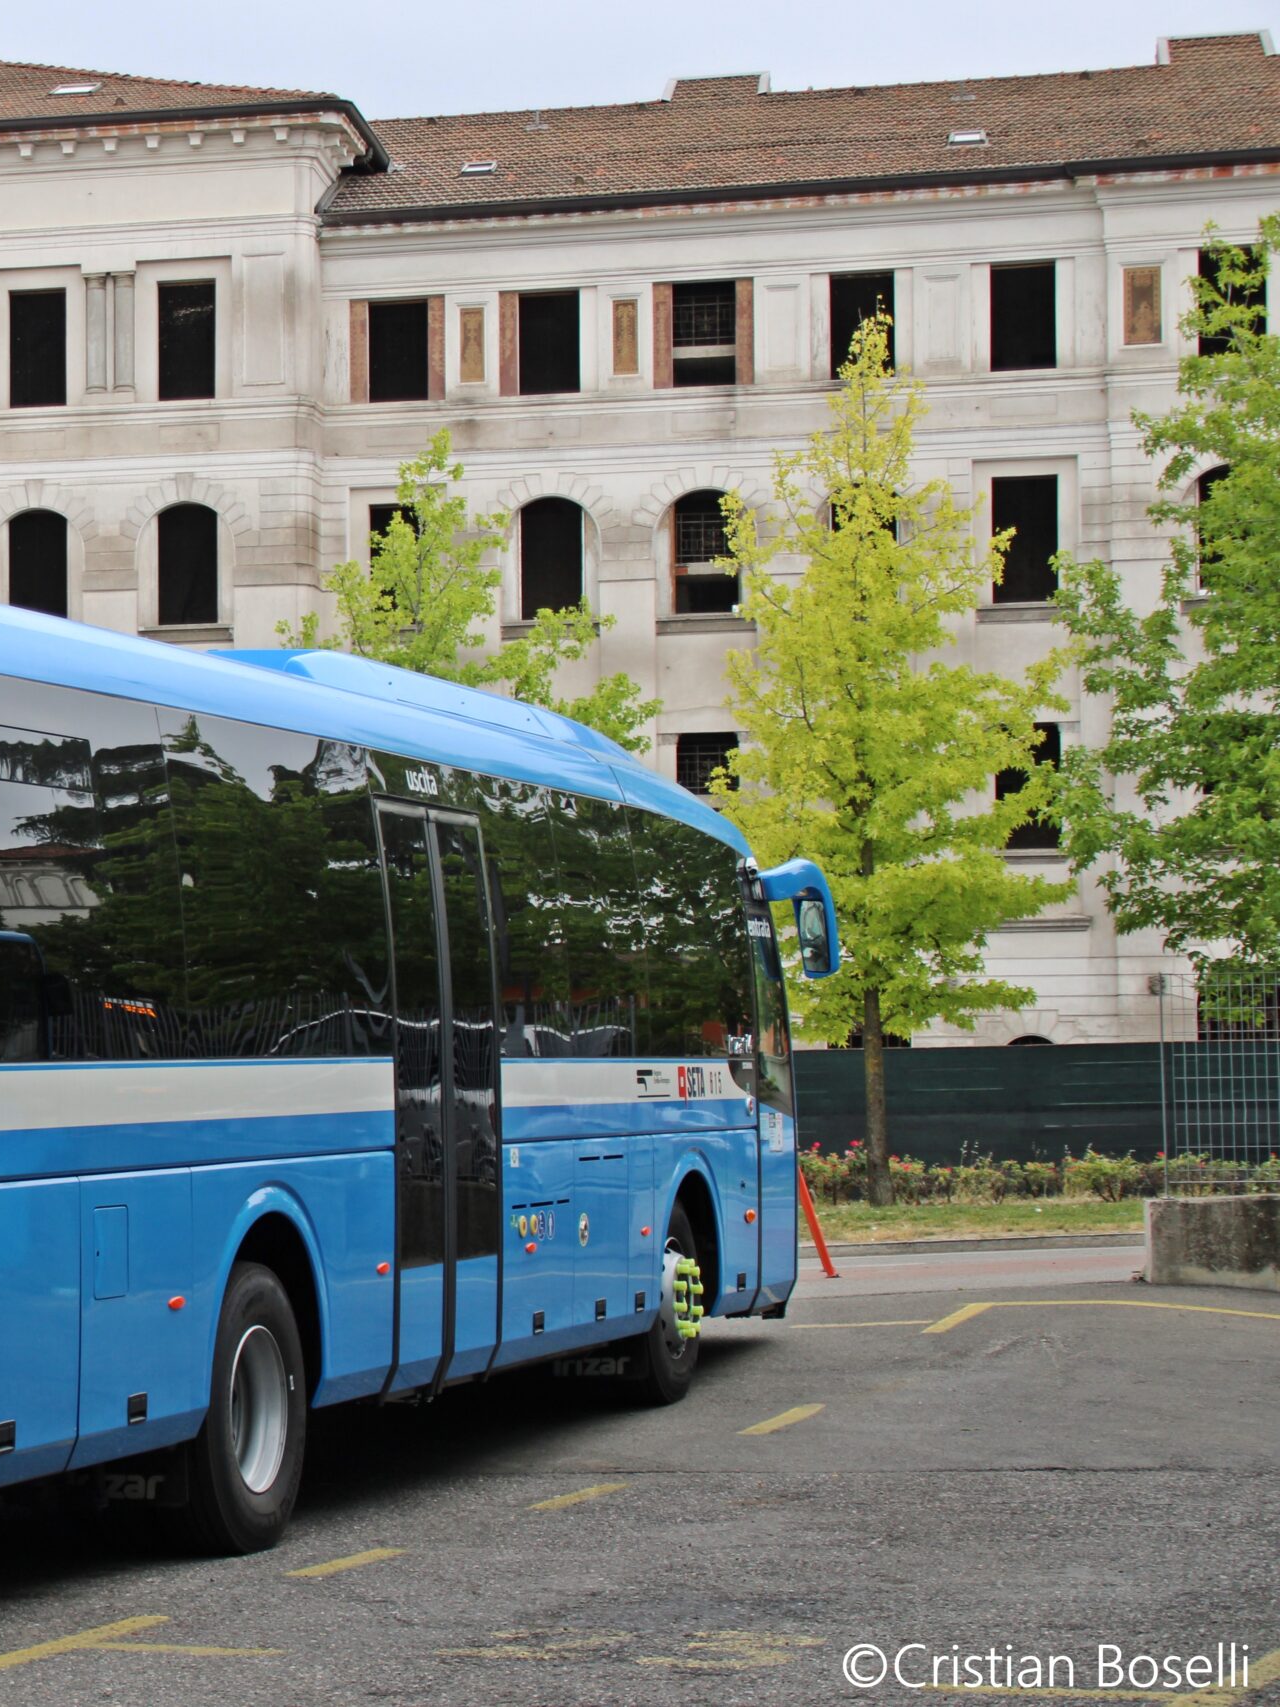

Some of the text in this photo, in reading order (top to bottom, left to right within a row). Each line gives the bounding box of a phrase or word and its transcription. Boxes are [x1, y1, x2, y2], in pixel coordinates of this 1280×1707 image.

[405, 766, 438, 795] uscita
[747, 917, 771, 938] entrata
[686, 1066, 705, 1098] SETA
[709, 1071, 722, 1095] 615
